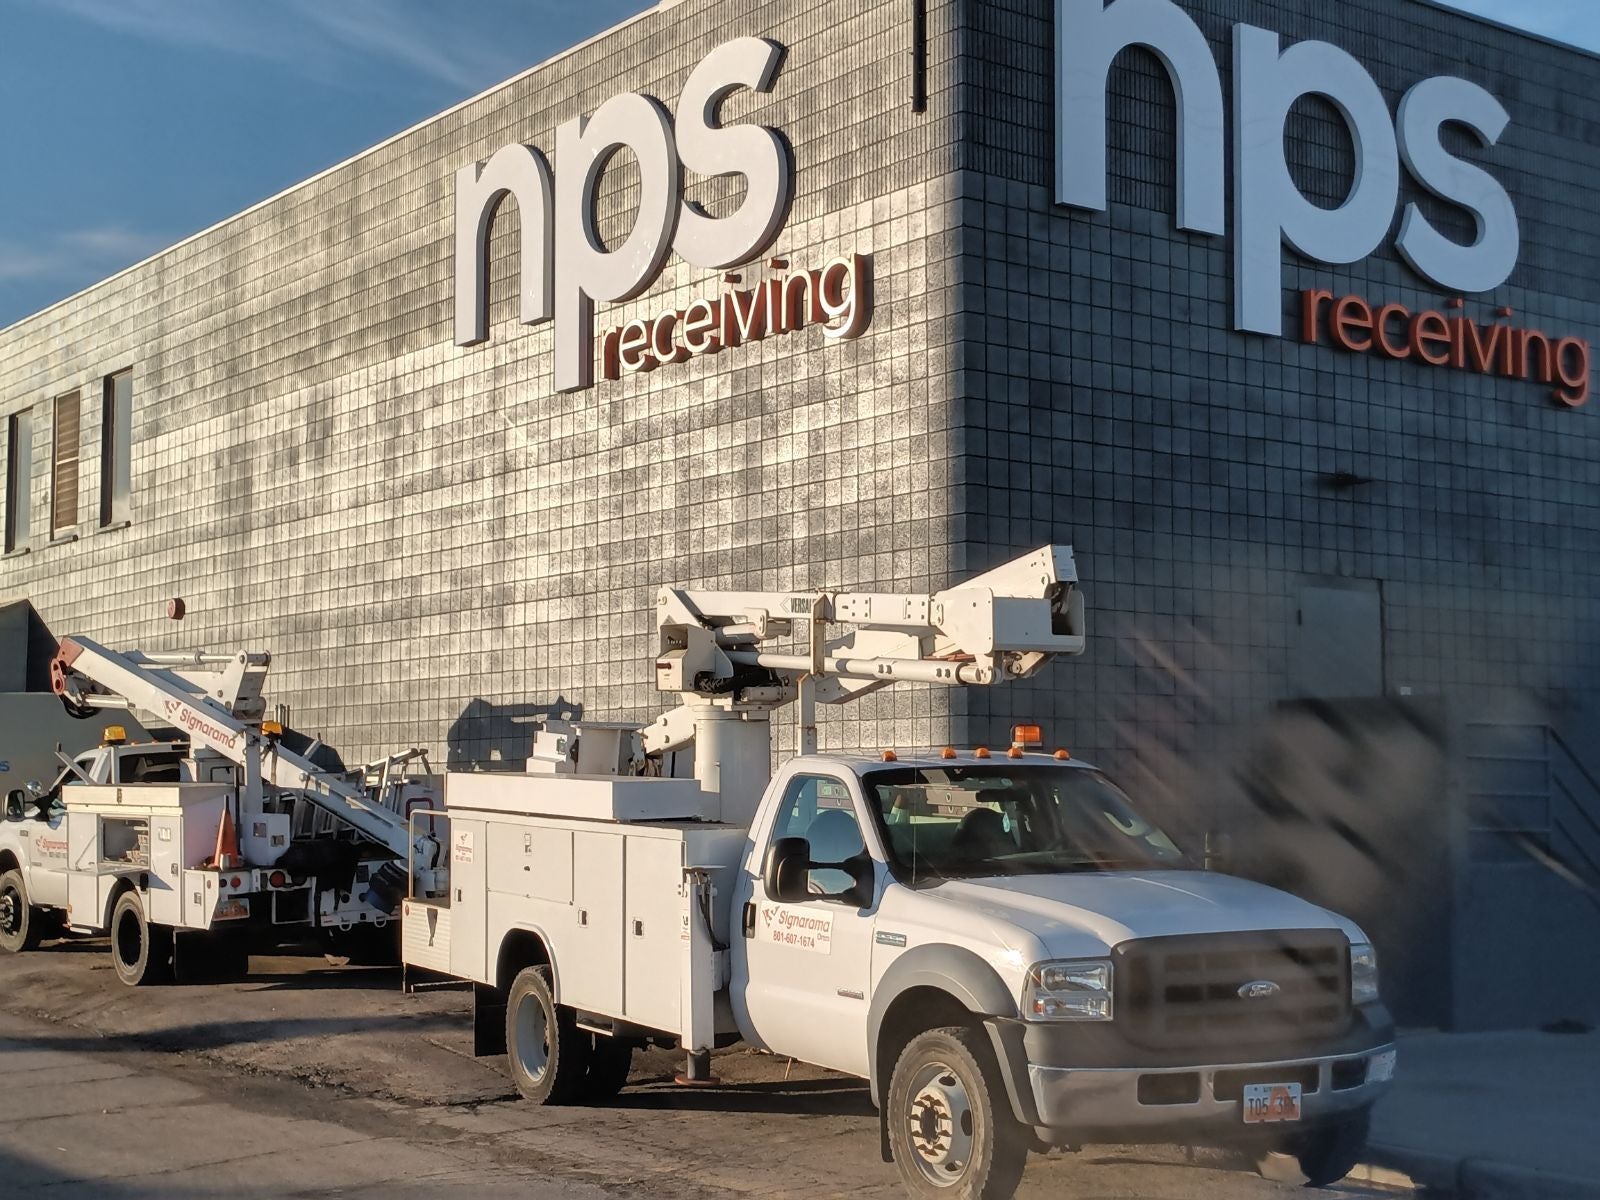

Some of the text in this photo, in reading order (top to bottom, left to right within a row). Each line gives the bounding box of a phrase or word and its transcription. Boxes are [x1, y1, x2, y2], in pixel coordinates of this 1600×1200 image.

[455, 36, 790, 392] nps
[1055, 0, 1520, 336] nps
[603, 253, 872, 379] receiving
[1301, 288, 1590, 407] receiving
[180, 708, 236, 749] Signarama
[779, 910, 831, 932] Signarama
